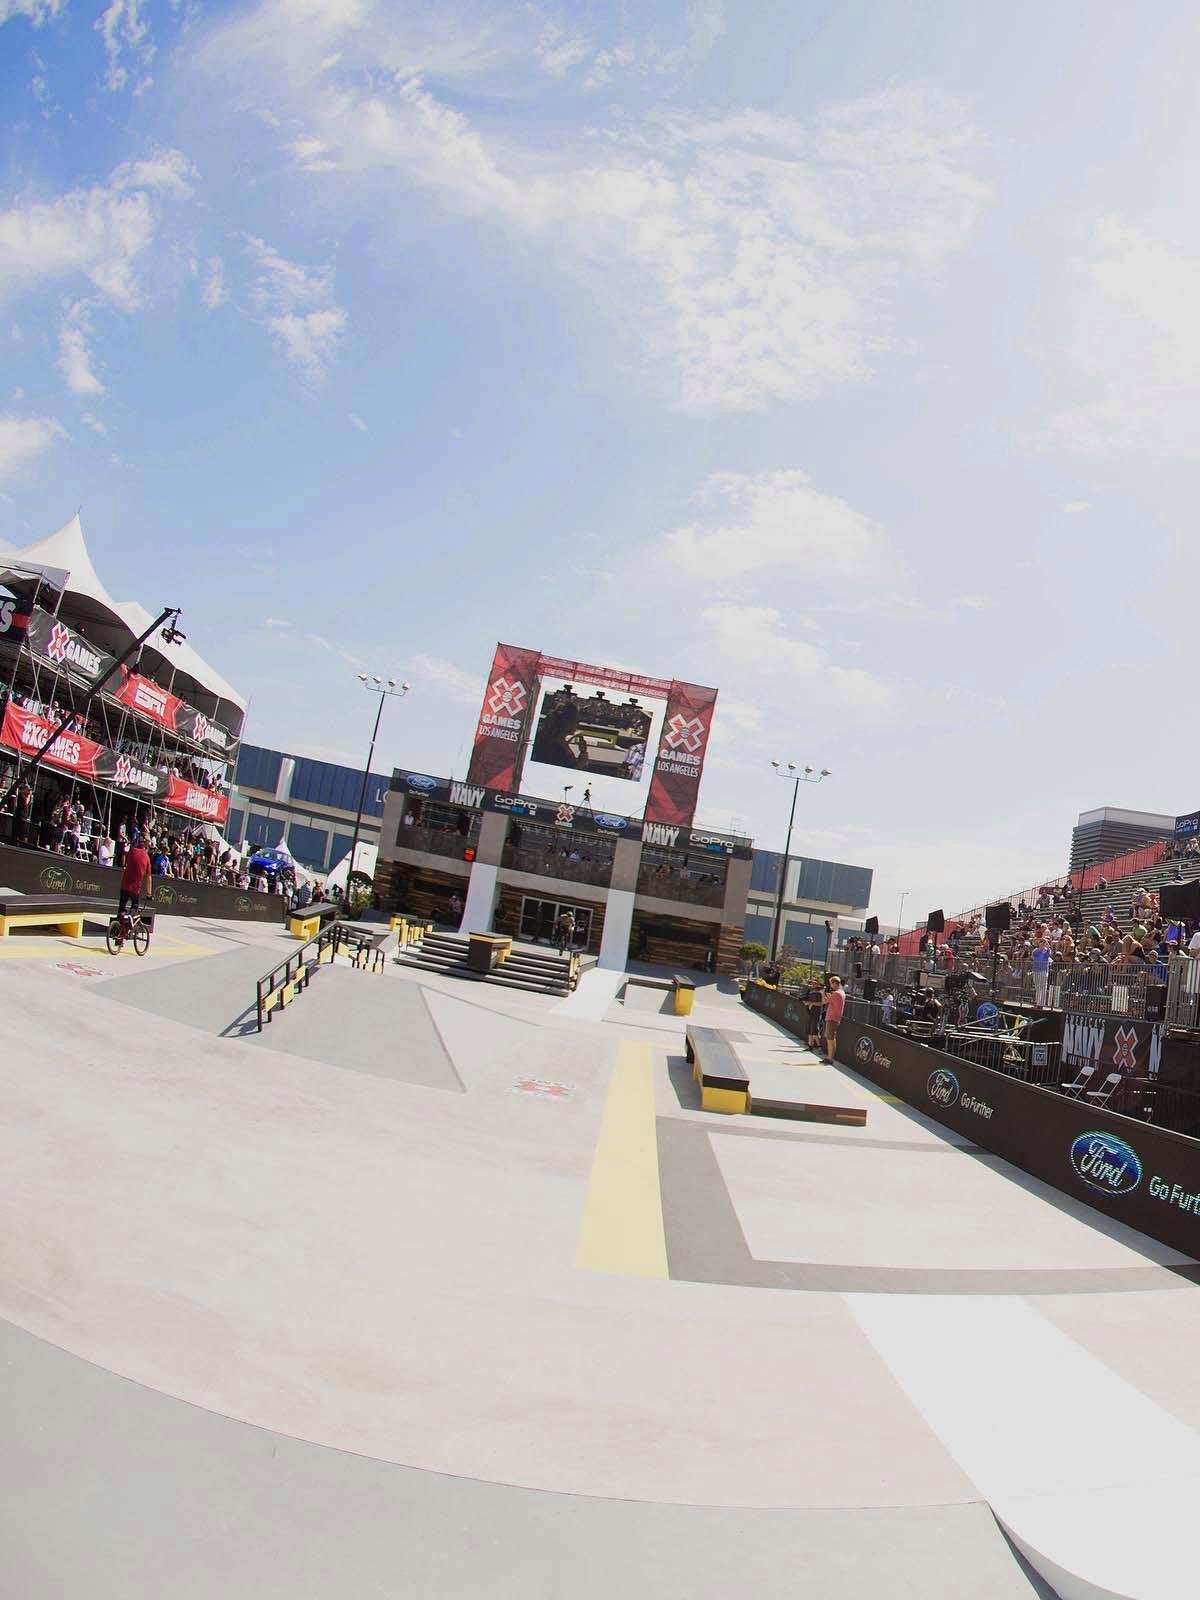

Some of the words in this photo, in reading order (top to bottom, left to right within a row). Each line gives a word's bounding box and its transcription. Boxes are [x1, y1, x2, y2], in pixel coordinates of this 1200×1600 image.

[66, 640, 101, 676] GAMES
[479, 724, 491, 736] LOS
[491, 727, 520, 742] ANGELES
[482, 713, 521, 730] GAMES
[205, 725, 228, 749] GAMES
[657, 760, 670, 772] LOS
[670, 763, 699, 778] ANGELES
[660, 748, 701, 766] GAMES
[129, 767, 159, 792] GAMES
[450, 783, 486, 808] NAVY
[494, 794, 538, 810] GoPro
[642, 823, 680, 848] NAVY
[690, 833, 735, 849] GoPro
[960, 1092, 970, 1108] Go
[970, 1096, 995, 1120] Further
[1080, 1138, 1130, 1188] Ford
[1149, 1174, 1169, 1201] Go
